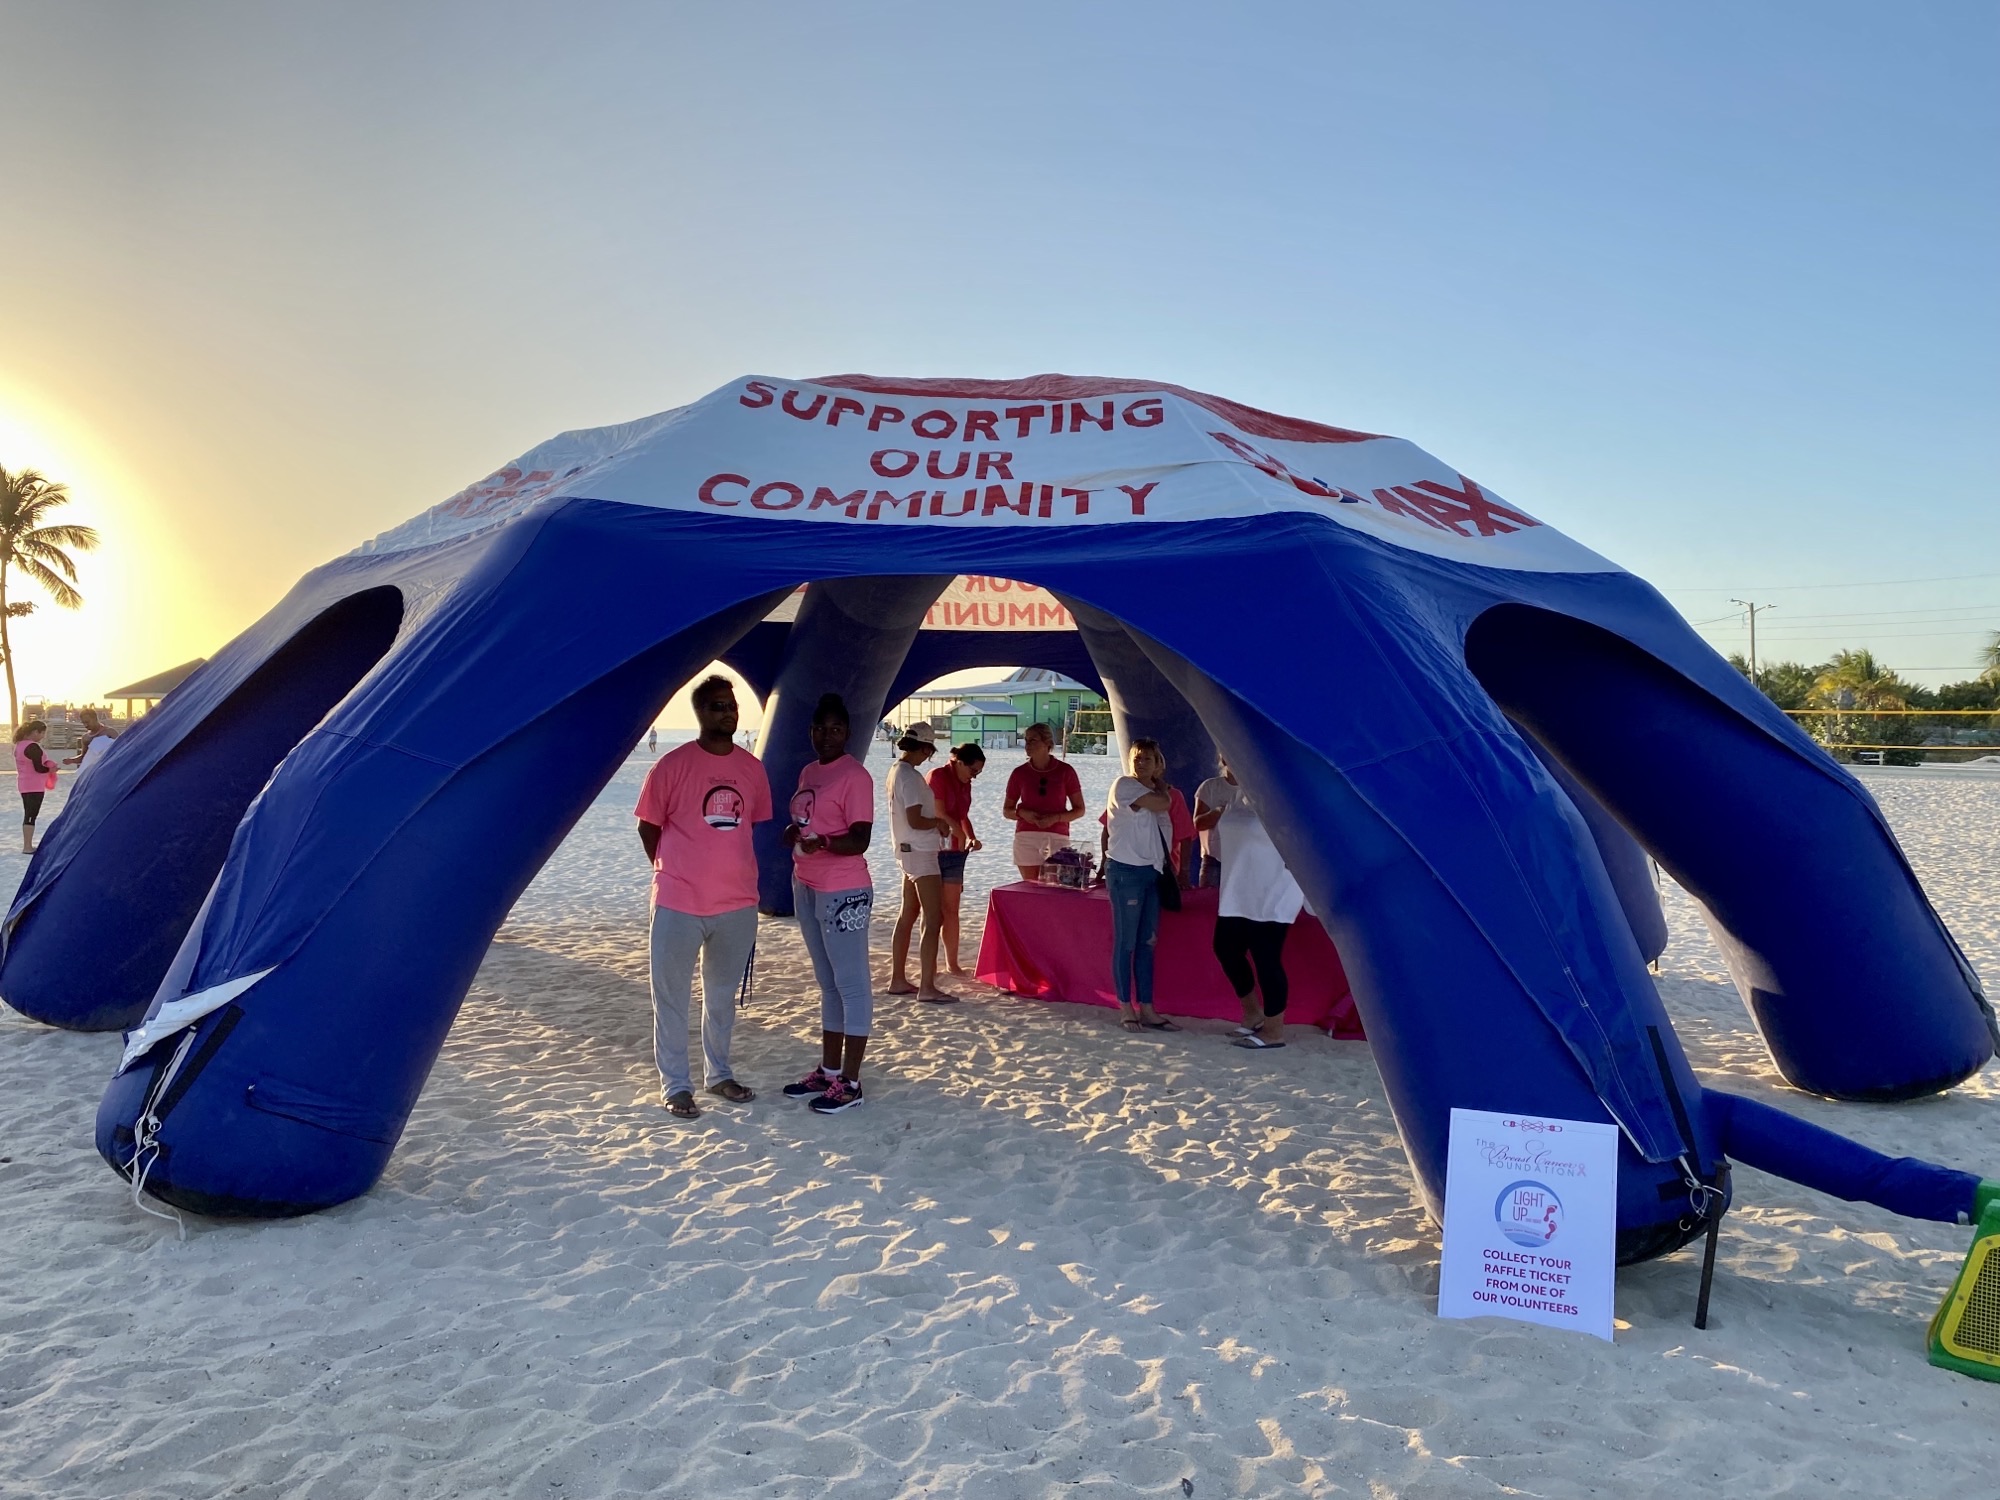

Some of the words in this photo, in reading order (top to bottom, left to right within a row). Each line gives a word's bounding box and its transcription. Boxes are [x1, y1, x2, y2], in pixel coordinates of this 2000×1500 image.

[739, 380, 1164, 442] SUPPORTING
[869, 448, 1015, 480] OUR
[697, 473, 1161, 520] COMMUNITY
[1480, 1145, 1532, 1163] Breast
[1525, 1139, 1577, 1168] Cancer
[1488, 1160, 1575, 1177] FOUNDATION
[1513, 1190, 1545, 1208] LIGHT
[1512, 1205, 1528, 1221] UP
[1483, 1249, 1537, 1265] COLLECT
[1539, 1256, 1572, 1270] YOUR
[1484, 1263, 1527, 1278] RAFFLE
[1529, 1270, 1571, 1284] TICKET
[1486, 1278, 1519, 1292] FROM
[1521, 1284, 1547, 1296] ONE
[1549, 1288, 1566, 1299] OF
[1472, 1291, 1498, 1303] OUR
[1500, 1295, 1578, 1316] VOLUNTEERS
